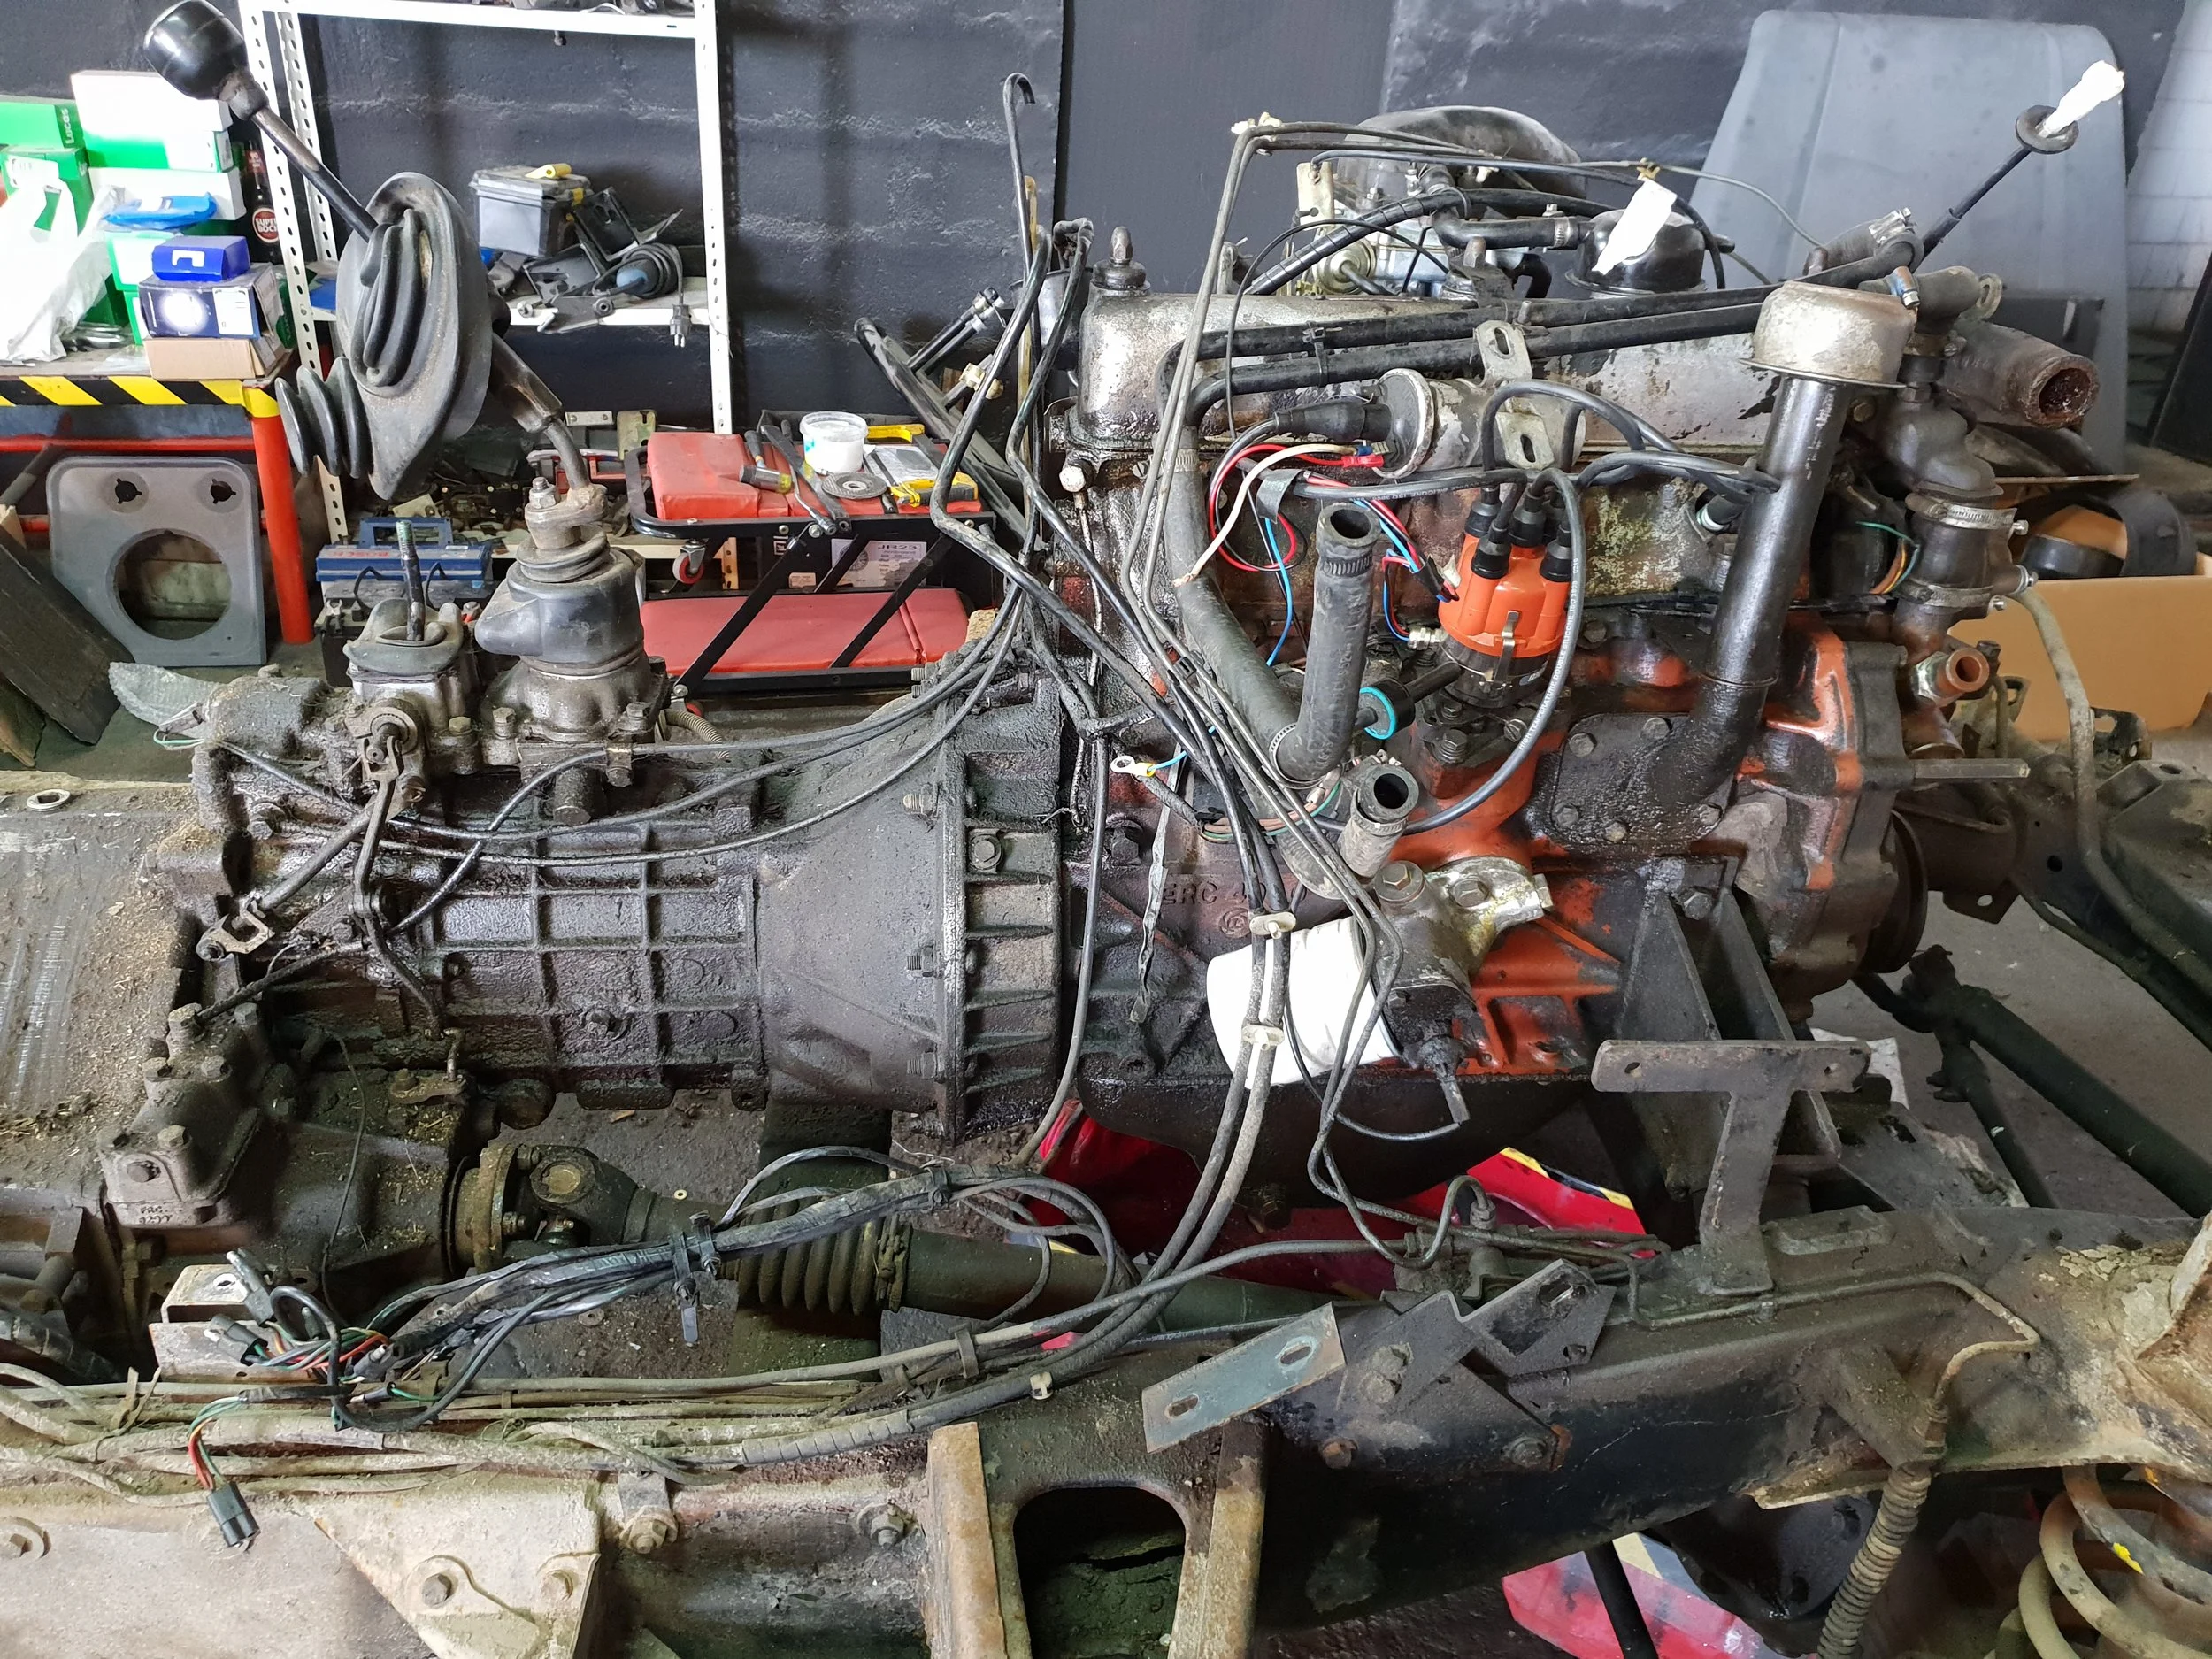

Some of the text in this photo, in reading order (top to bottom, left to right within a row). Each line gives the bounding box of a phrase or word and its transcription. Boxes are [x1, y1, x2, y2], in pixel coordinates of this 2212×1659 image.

[1518, 733, 1532, 750] HIGH
[1530, 680, 1556, 733] TEMPERATURE
[1553, 650, 1567, 680] DOUBLE
[1561, 615, 1573, 649] SILICONE
